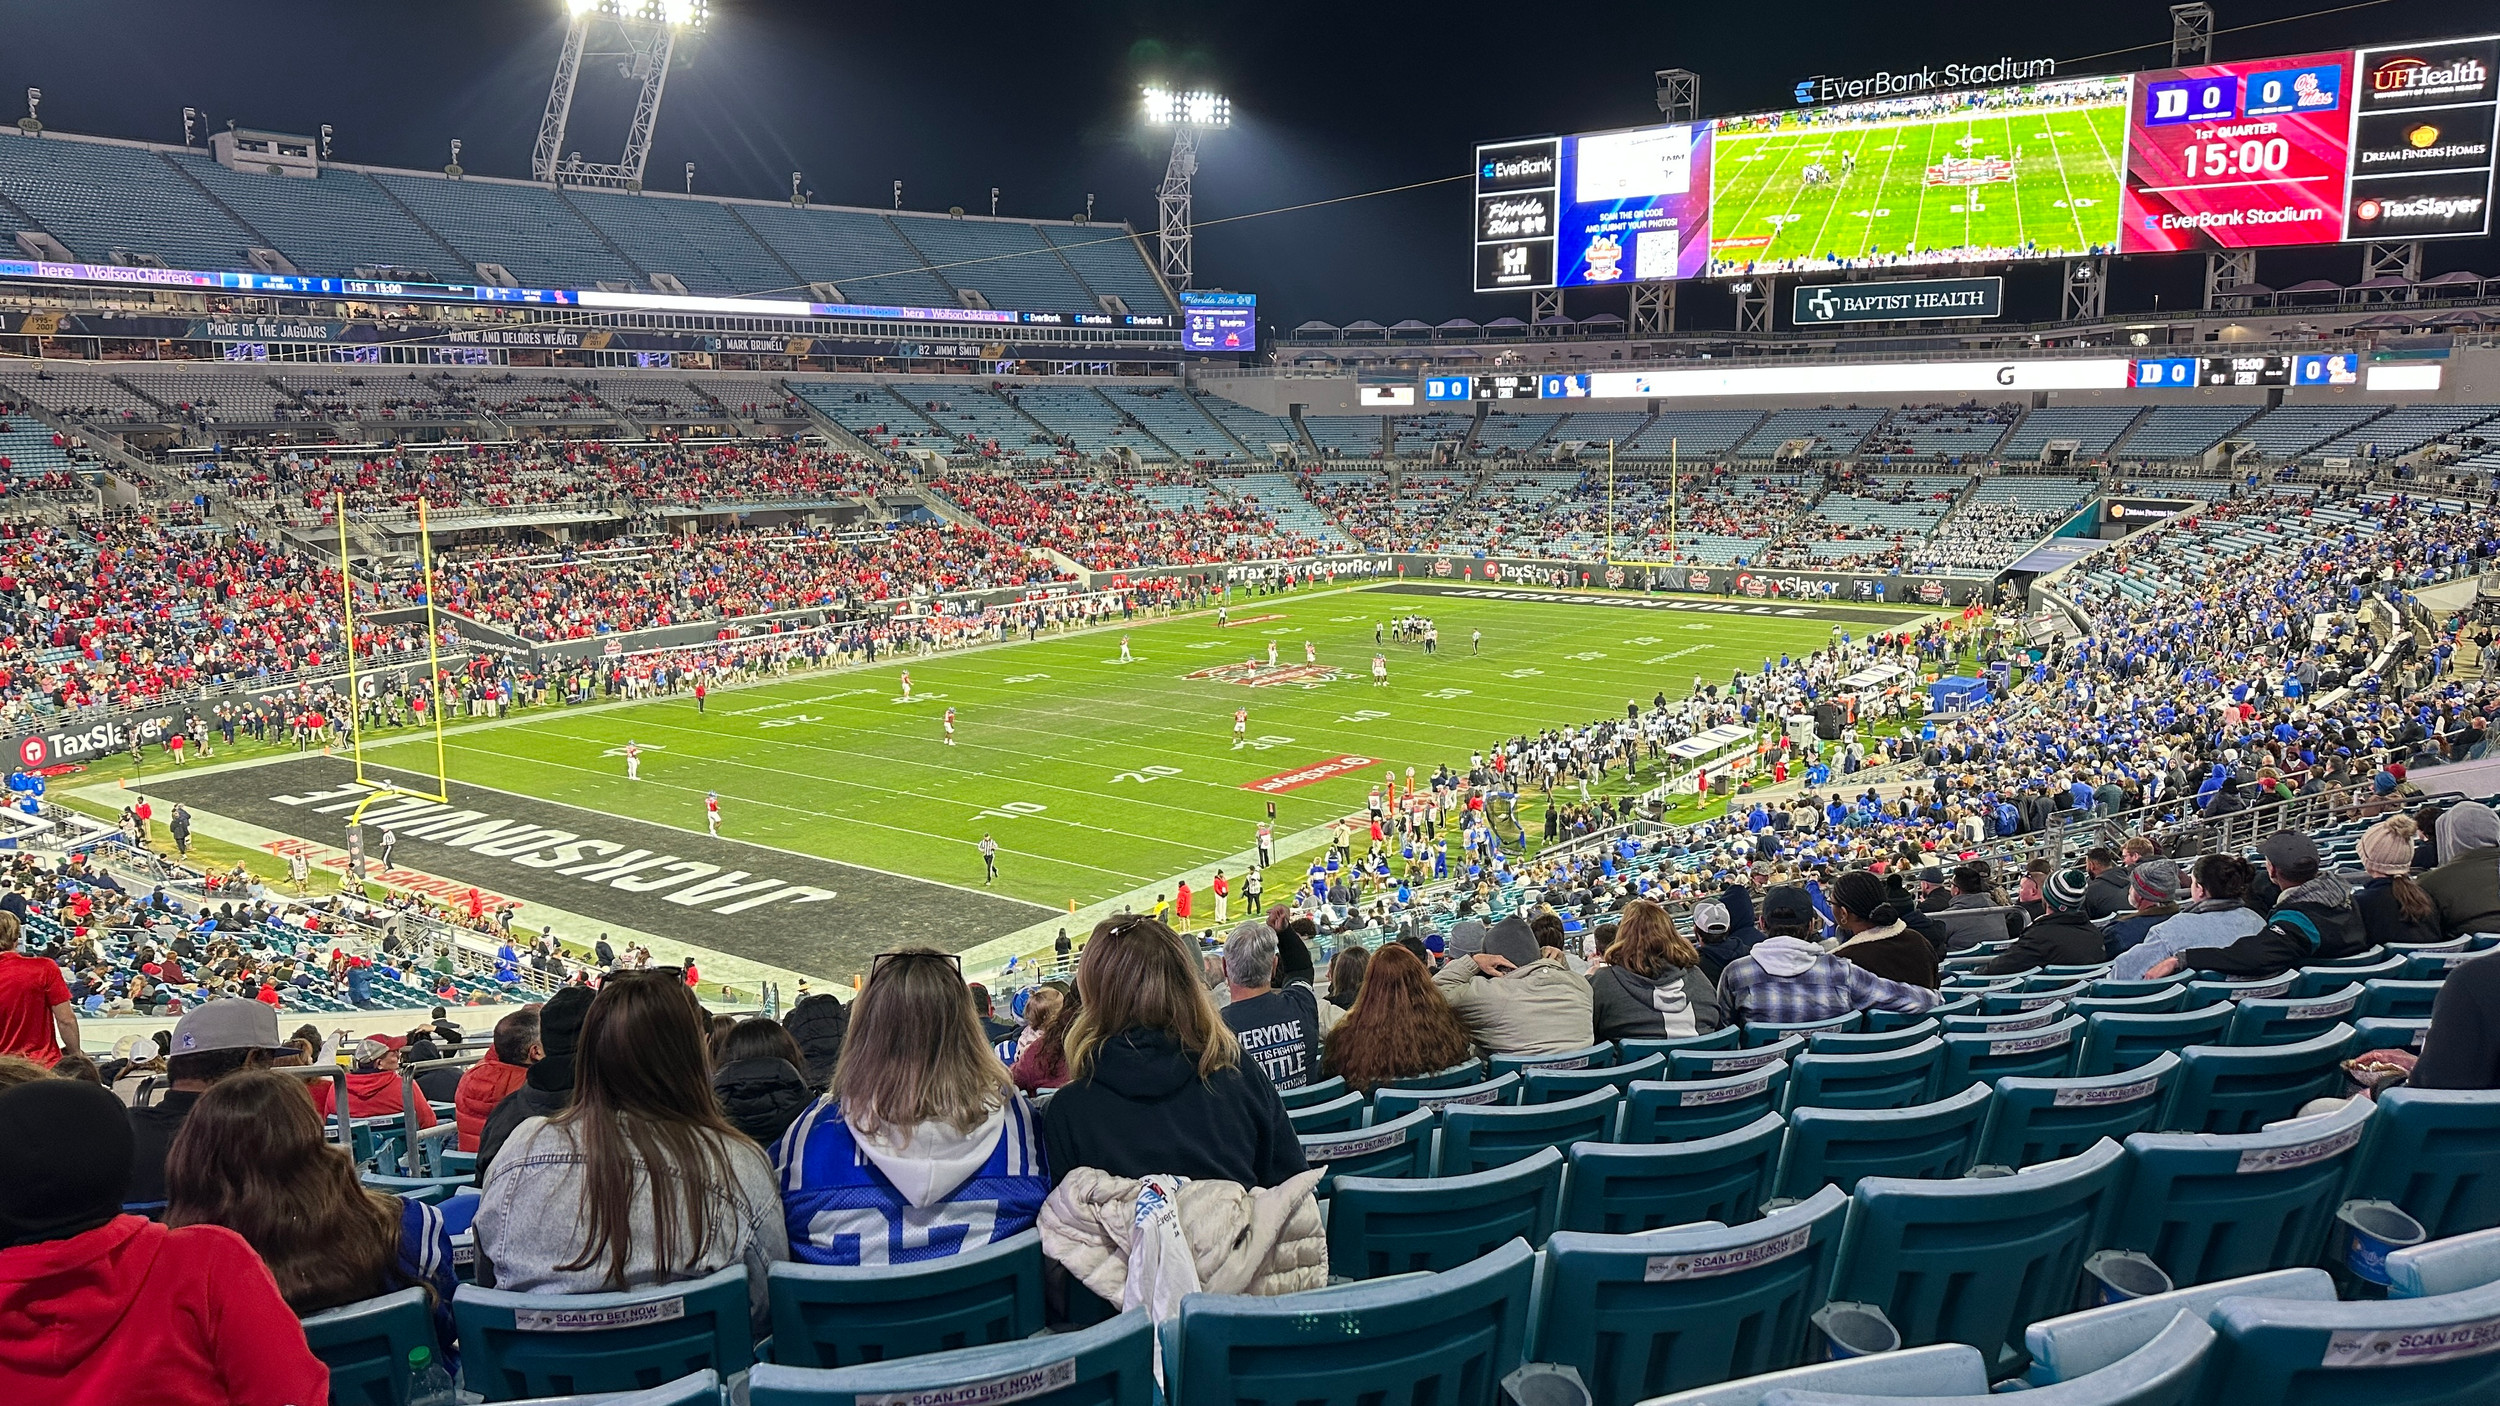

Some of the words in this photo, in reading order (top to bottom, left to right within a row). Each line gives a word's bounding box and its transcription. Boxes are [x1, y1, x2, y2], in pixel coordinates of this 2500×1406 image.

[1821, 66, 1936, 100] EverBank
[1944, 57, 2055, 86] Stadium
[2203, 86, 2220, 109] 0
[2263, 80, 2281, 103] 0
[2154, 89, 2189, 118] D
[2217, 122, 2277, 138] QUARTER
[2184, 138, 2289, 178] 15:00
[2362, 150, 2400, 163] DREAM
[2402, 147, 2444, 160] FINDERS
[2446, 145, 2485, 157] HOMES
[1495, 157, 1552, 177] EverBank
[1489, 197, 1545, 219] Florida
[1600, 212, 1617, 222] SCAN
[1619, 211, 1632, 220] THE
[1634, 209, 1644, 219] QR
[1645, 208, 1664, 218] CODE
[2380, 198, 2483, 219] TaxSlayer
[1488, 218, 1519, 235] Blue
[1585, 224, 1600, 233] AND
[1601, 222, 1626, 232] SUBMIT
[1628, 220, 1646, 230] YOUR
[1648, 218, 1678, 228] PHOTOS!
[2162, 208, 2244, 229] EverBank
[2246, 206, 2322, 225] Stadium
[38, 262, 74, 278] here
[85, 265, 136, 281] Wolfson
[136, 268, 193, 284] Children's
[2077, 268, 2091, 279] 25
[321, 280, 330, 291] 0
[350, 282, 367, 292] 1ST
[375, 283, 402, 294] 15:00
[1731, 283, 1752, 294] 15:00
[1185, 296, 1216, 304] Florida
[1844, 296, 1912, 313] BAPTIST
[1916, 290, 1985, 308] HEALTH
[903, 307, 925, 318] here
[931, 308, 962, 320] Wolfson
[963, 310, 998, 322] Children's
[1030, 313, 1061, 323] EverBank
[1081, 315, 1112, 324] EverBank
[1132, 317, 1163, 325] EverBank
[207, 322, 237, 337] PRIDE
[242, 323, 255, 337] OF
[257, 324, 277, 338] THE
[280, 325, 327, 339] JAGUARS
[448, 330, 479, 343] WAYNE
[482, 331, 500, 343] AND
[503, 331, 541, 344] DELORES
[543, 333, 578, 346] WEAVER
[726, 339, 749, 350] MARK
[751, 339, 784, 351] BRUNELL
[918, 345, 930, 355] 82
[934, 346, 957, 356] JIMMY
[959, 346, 980, 356] SMITH
[2141, 364, 2162, 383] D
[2172, 364, 2185, 382] 0
[2232, 359, 2264, 371] 15:00
[2306, 361, 2320, 379] 0
[1997, 366, 2015, 385] G
[1451, 382, 1462, 396] 0
[1441, 589, 1818, 616] JACKSONVILLE
[48, 718, 162, 759] TaxSlaer
[269, 782, 837, 915] JACKSONVILLE
[1264, 1049, 1272, 1059] IS
[1273, 1041, 1306, 1057] FIGHTING
[1274, 1073, 1307, 1091] NOTHING
[1378, 1136, 1393, 1144] NOW
[1694, 1257, 1727, 1267] SCAN
[1729, 1253, 1743, 1262] TO
[1745, 1247, 1765, 1259] BET
[1766, 1237, 1791, 1251] NOW
[556, 1313, 587, 1323] SCAN
[589, 1313, 604, 1321] TO
[607, 1311, 627, 1320] BET
[630, 1305, 657, 1317] NOW
[2400, 1333, 2447, 1347] SCAN
[2451, 1330, 2471, 1342] TO
[2473, 1324, 2498, 1339] BET
[912, 1393, 954, 1406] SCAN
[958, 1389, 976, 1401] TO
[980, 1382, 1007, 1396] BET
[1010, 1372, 1044, 1389] NOW
